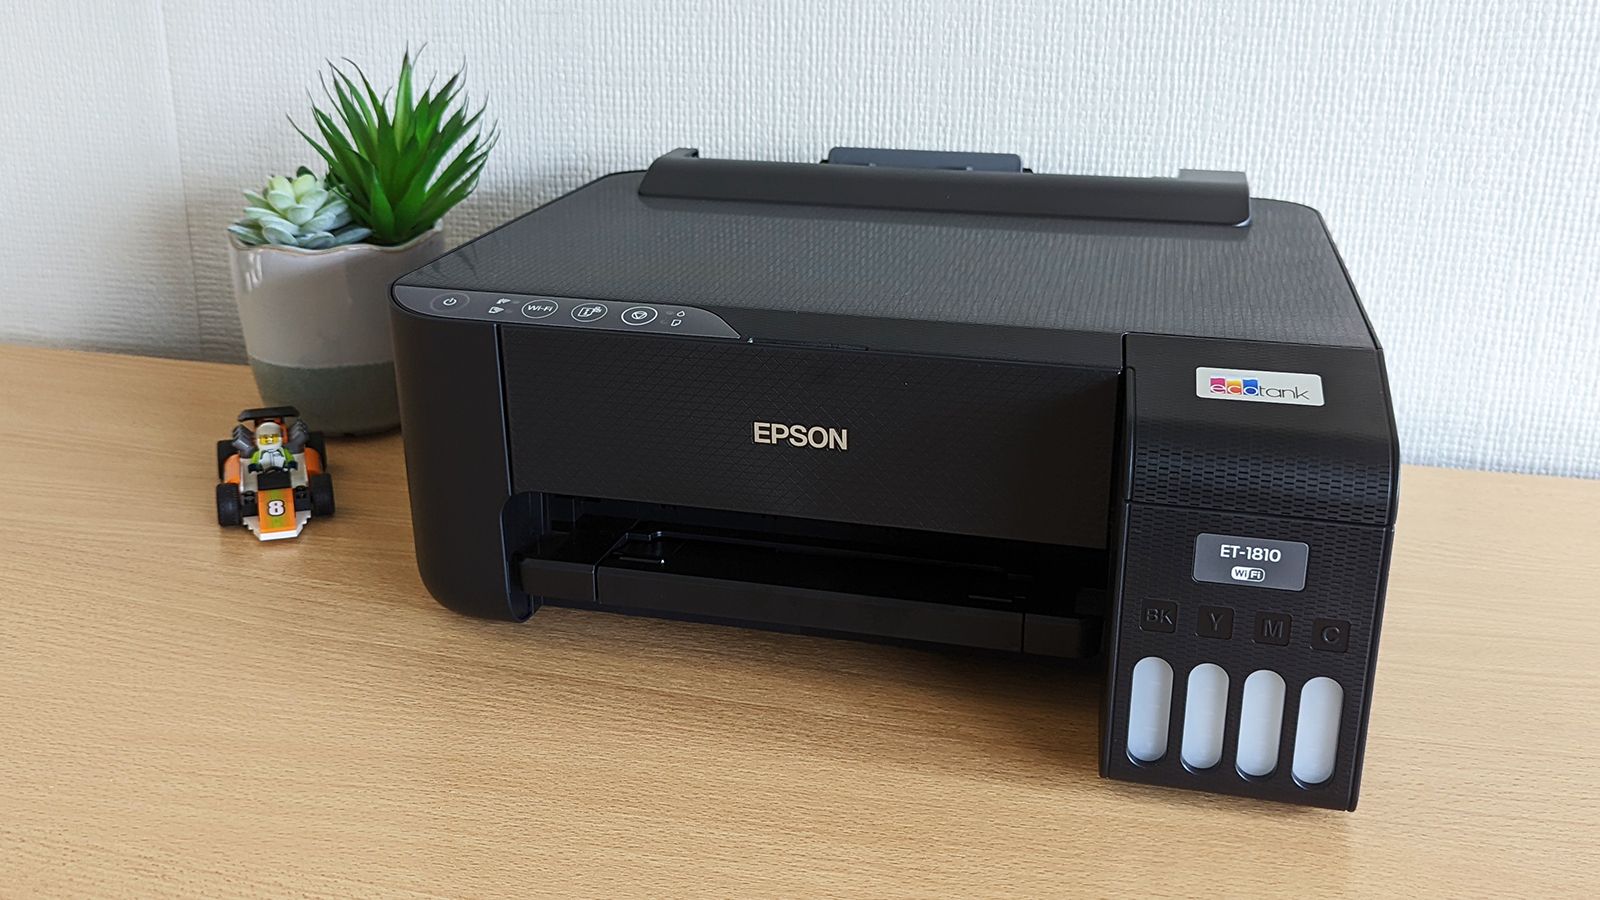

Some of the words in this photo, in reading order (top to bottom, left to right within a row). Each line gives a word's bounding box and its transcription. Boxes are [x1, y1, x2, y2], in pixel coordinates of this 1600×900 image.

[528, 304, 553, 312] Wi-Fi
[1210, 378, 1309, 400] ecotank
[753, 421, 848, 450] EPSON
[268, 499, 285, 516] 8
[1220, 544, 1281, 562] ET-1810
[1146, 608, 1173, 625] BK
[1210, 612, 1225, 631] Y
[1263, 618, 1284, 638] M
[1323, 626, 1341, 643] C
